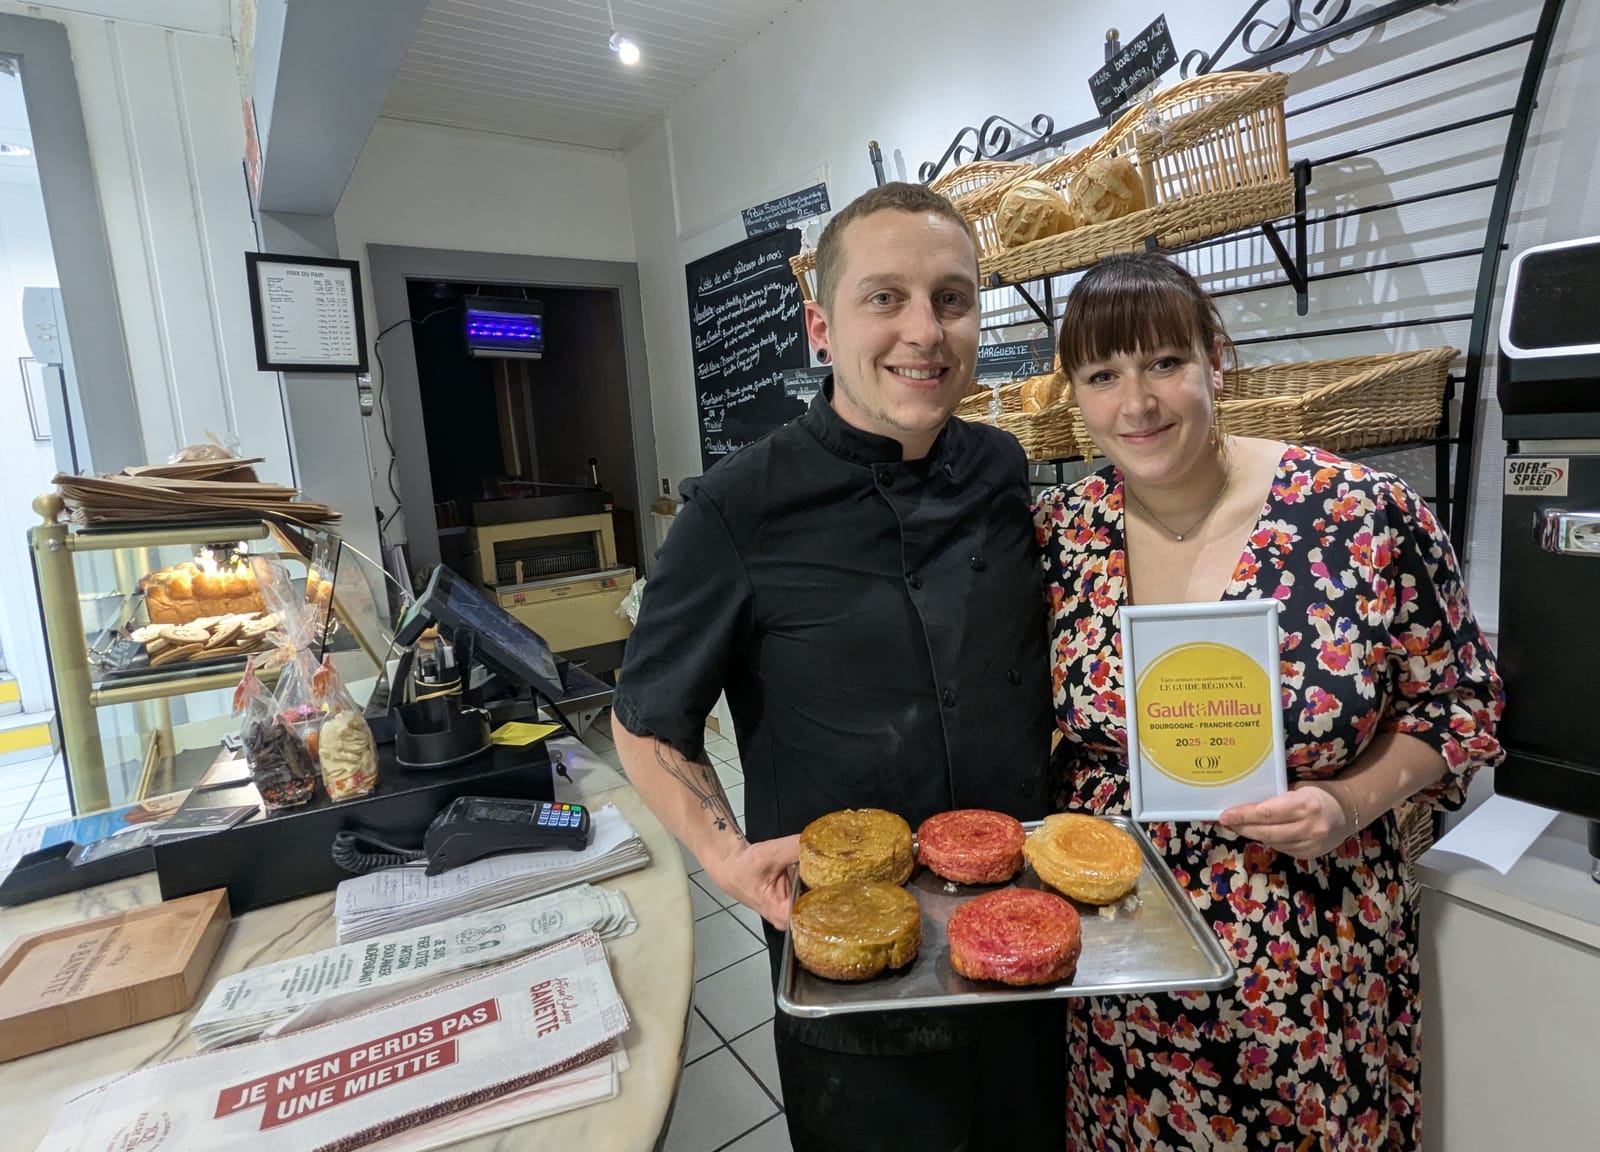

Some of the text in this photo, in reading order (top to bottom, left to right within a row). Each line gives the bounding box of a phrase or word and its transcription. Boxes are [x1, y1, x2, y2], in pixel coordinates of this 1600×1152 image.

[714, 273, 722, 284] de
[1513, 474, 1552, 486] SPEED
[1202, 682, 1246, 690] RÉGIONAL
[1200, 720, 1260, 728] FRANCHE-COMTÉ
[1176, 738, 1200, 746] 2025
[1210, 738, 1236, 746] 2026
[378, 944, 396, 978] BOULANGER
[396, 945, 412, 969] ARTISAN
[530, 980, 560, 1038] BANETTE
[231, 1007, 488, 1110] JE N'EN PERDS PAS
[278, 1050, 442, 1120] UNE MIETTE
